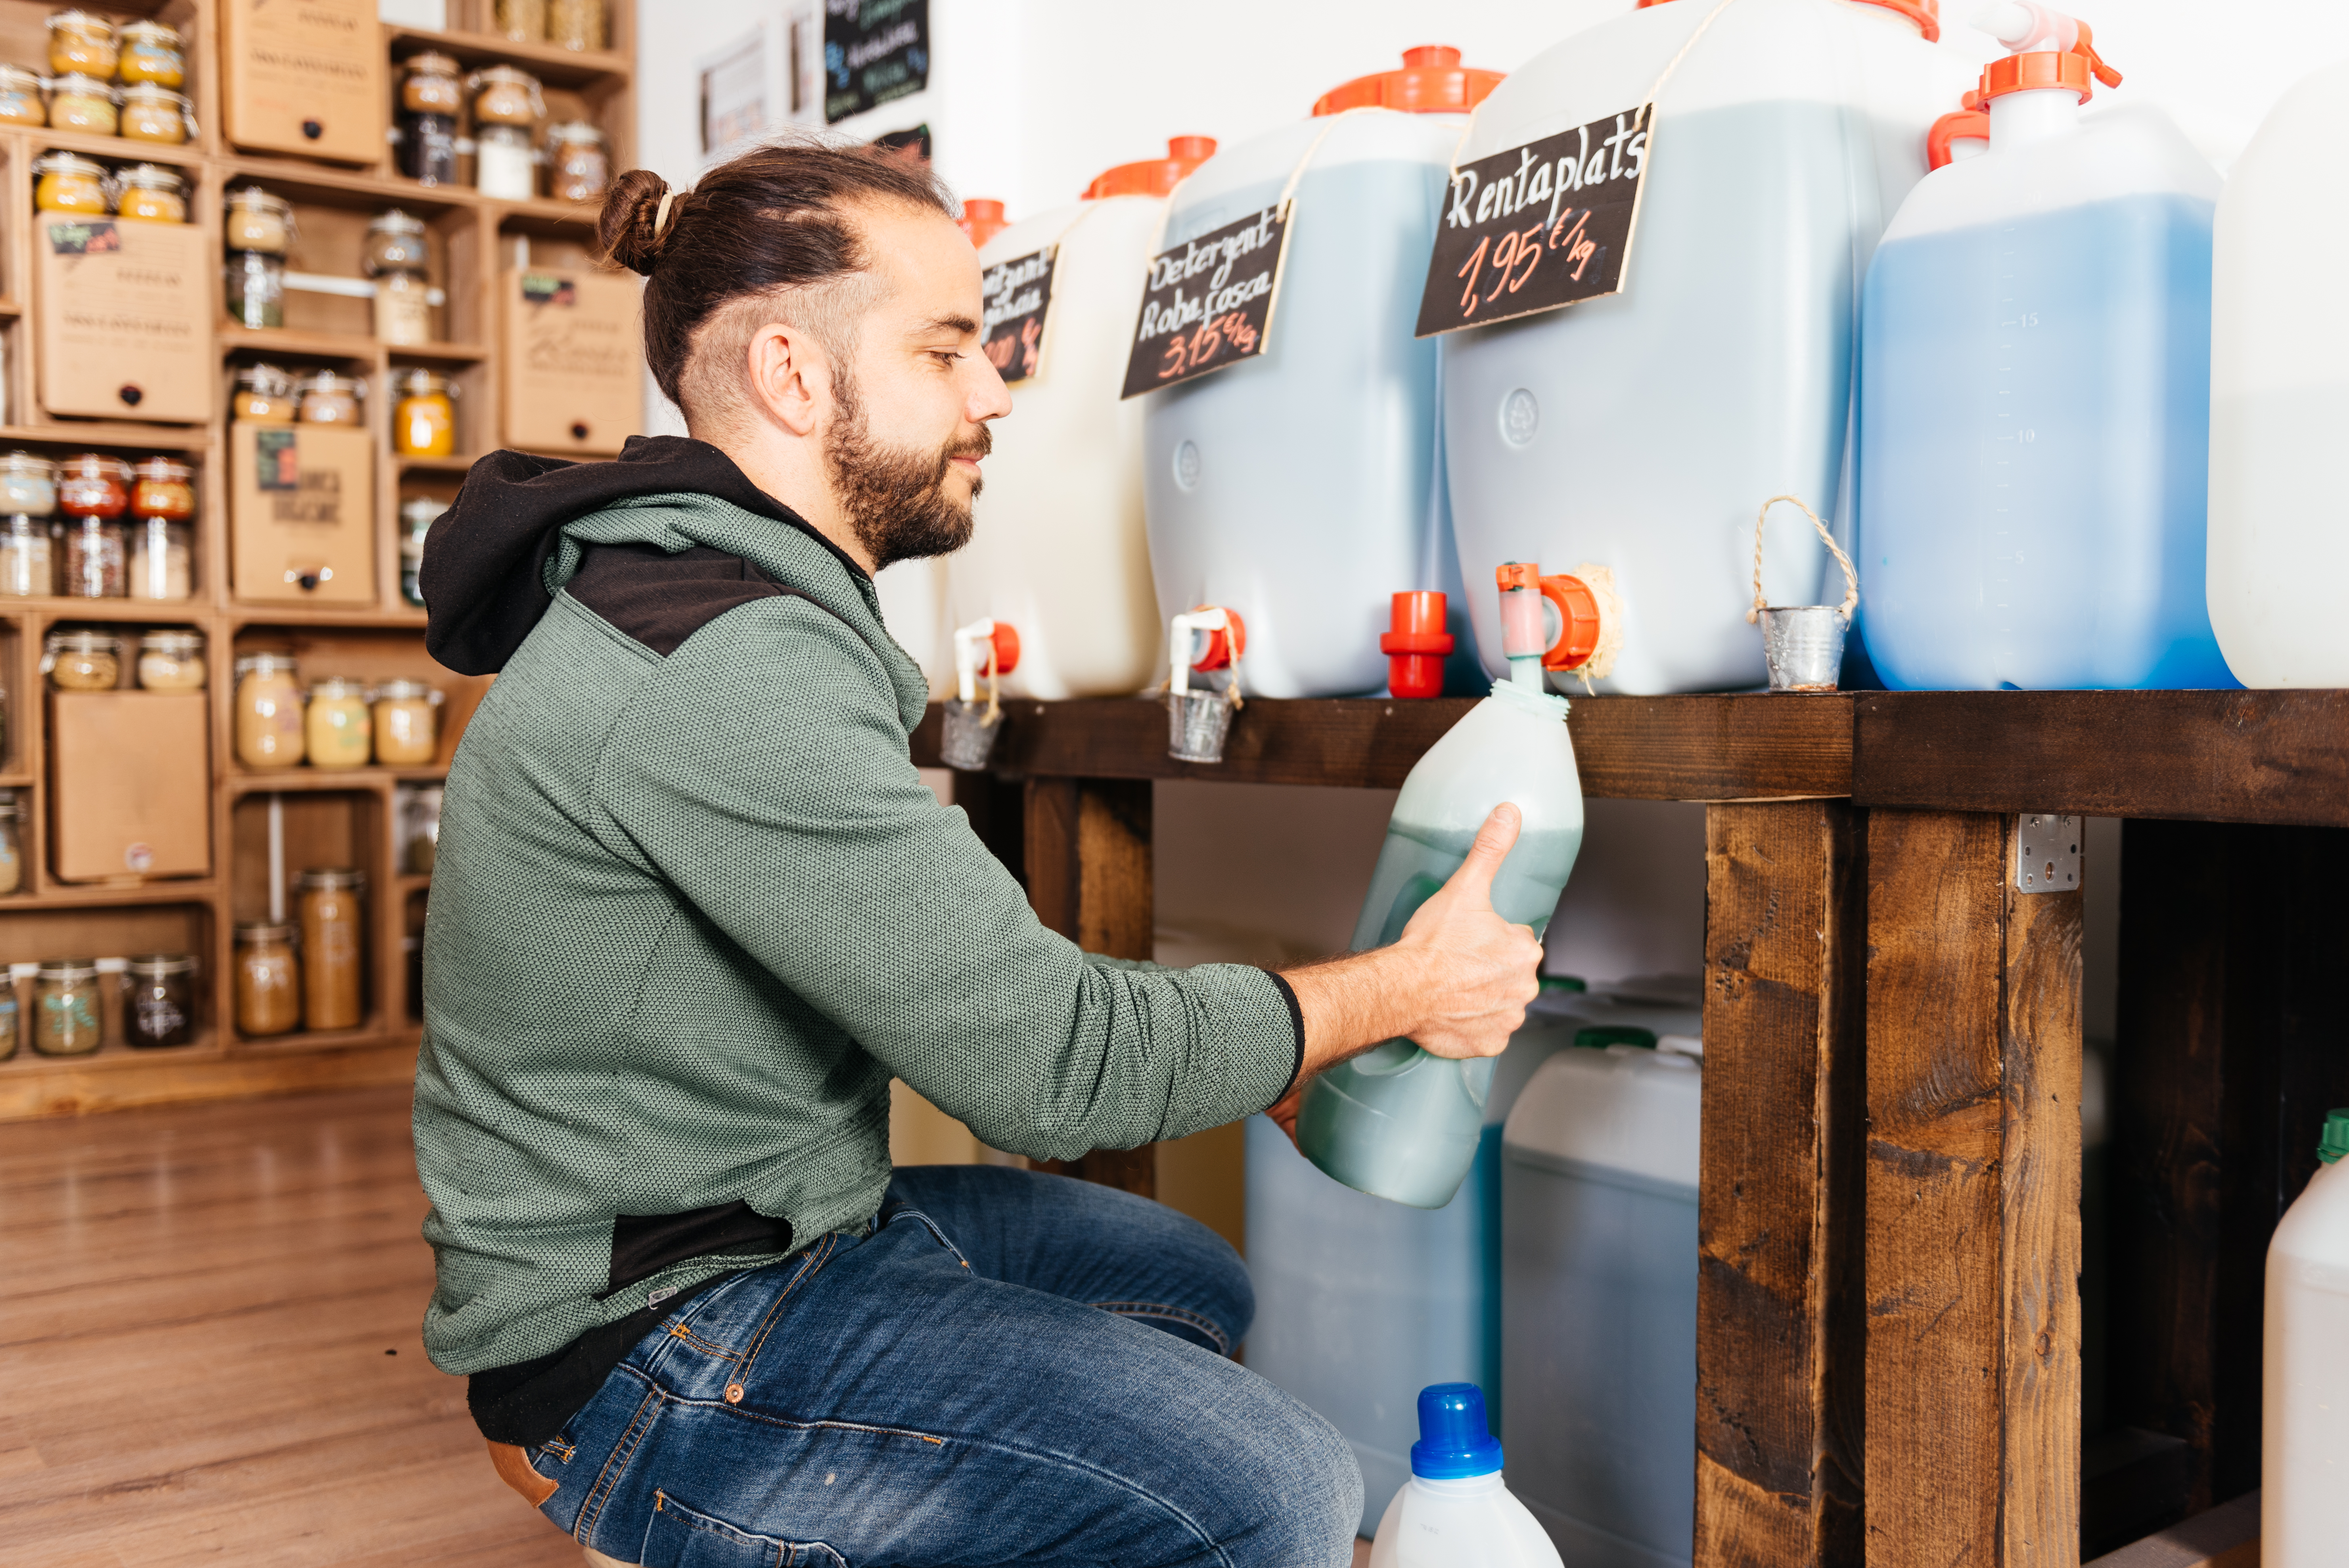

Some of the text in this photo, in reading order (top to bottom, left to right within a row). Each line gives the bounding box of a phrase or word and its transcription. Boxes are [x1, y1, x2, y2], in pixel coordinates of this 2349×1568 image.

[1446, 114, 1647, 230] Rentaplats
[1151, 209, 1276, 292] Detergent
[1139, 271, 1272, 341] Roba fosca
[2019, 312, 2038, 328] 15
[2016, 429, 2035, 444] 10
[2015, 550, 2024, 565] 5
